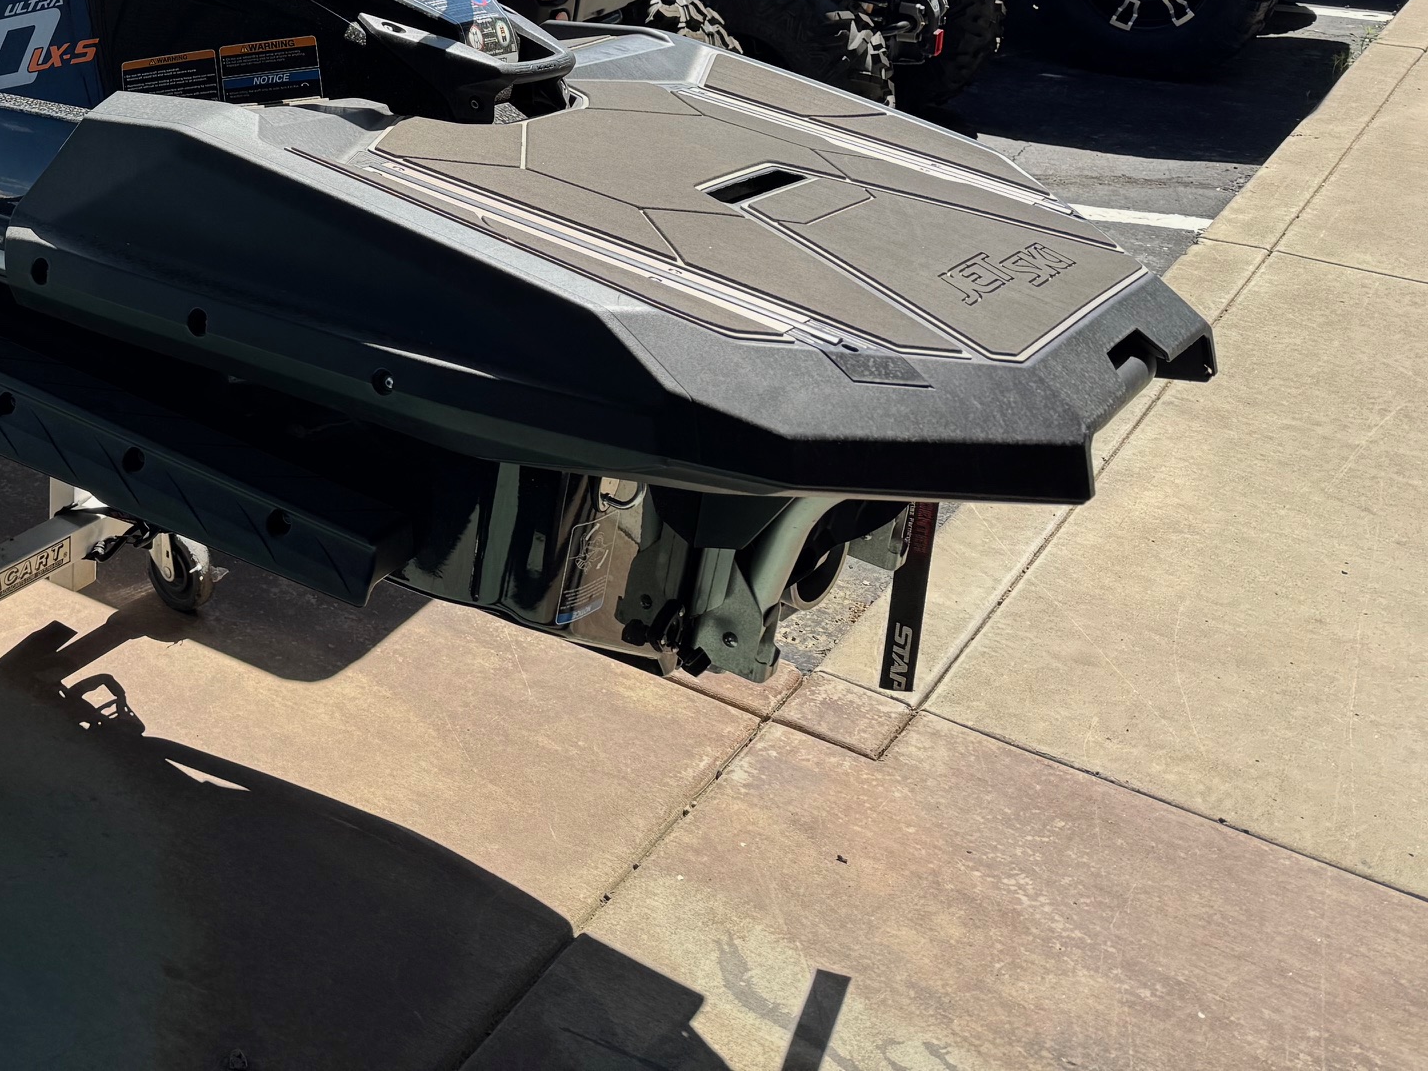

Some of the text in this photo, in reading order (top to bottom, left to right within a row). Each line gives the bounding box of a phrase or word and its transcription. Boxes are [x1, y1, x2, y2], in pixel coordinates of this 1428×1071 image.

[248, 39, 295, 52] WARNING
[27, 37, 100, 73] LX-S
[157, 54, 188, 64] WARNING
[253, 73, 290, 86] NOTICE
